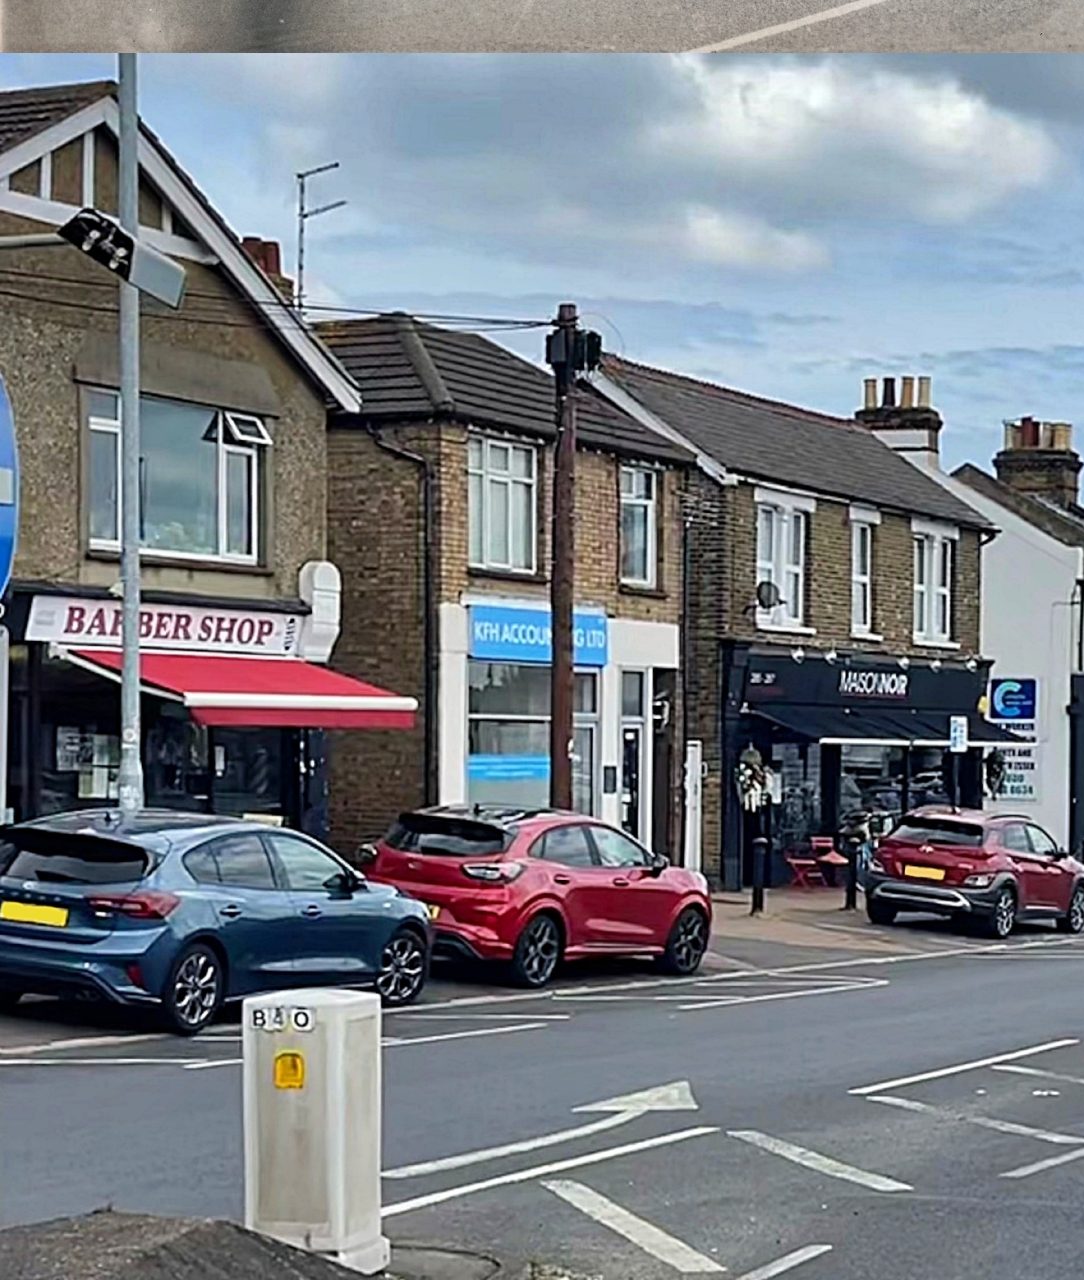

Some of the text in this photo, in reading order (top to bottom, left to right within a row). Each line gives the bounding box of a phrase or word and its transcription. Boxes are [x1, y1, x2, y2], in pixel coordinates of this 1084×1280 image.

[198, 615, 274, 645] SHOP
[474, 622, 500, 641] KFH
[587, 630, 606, 648] LTD
